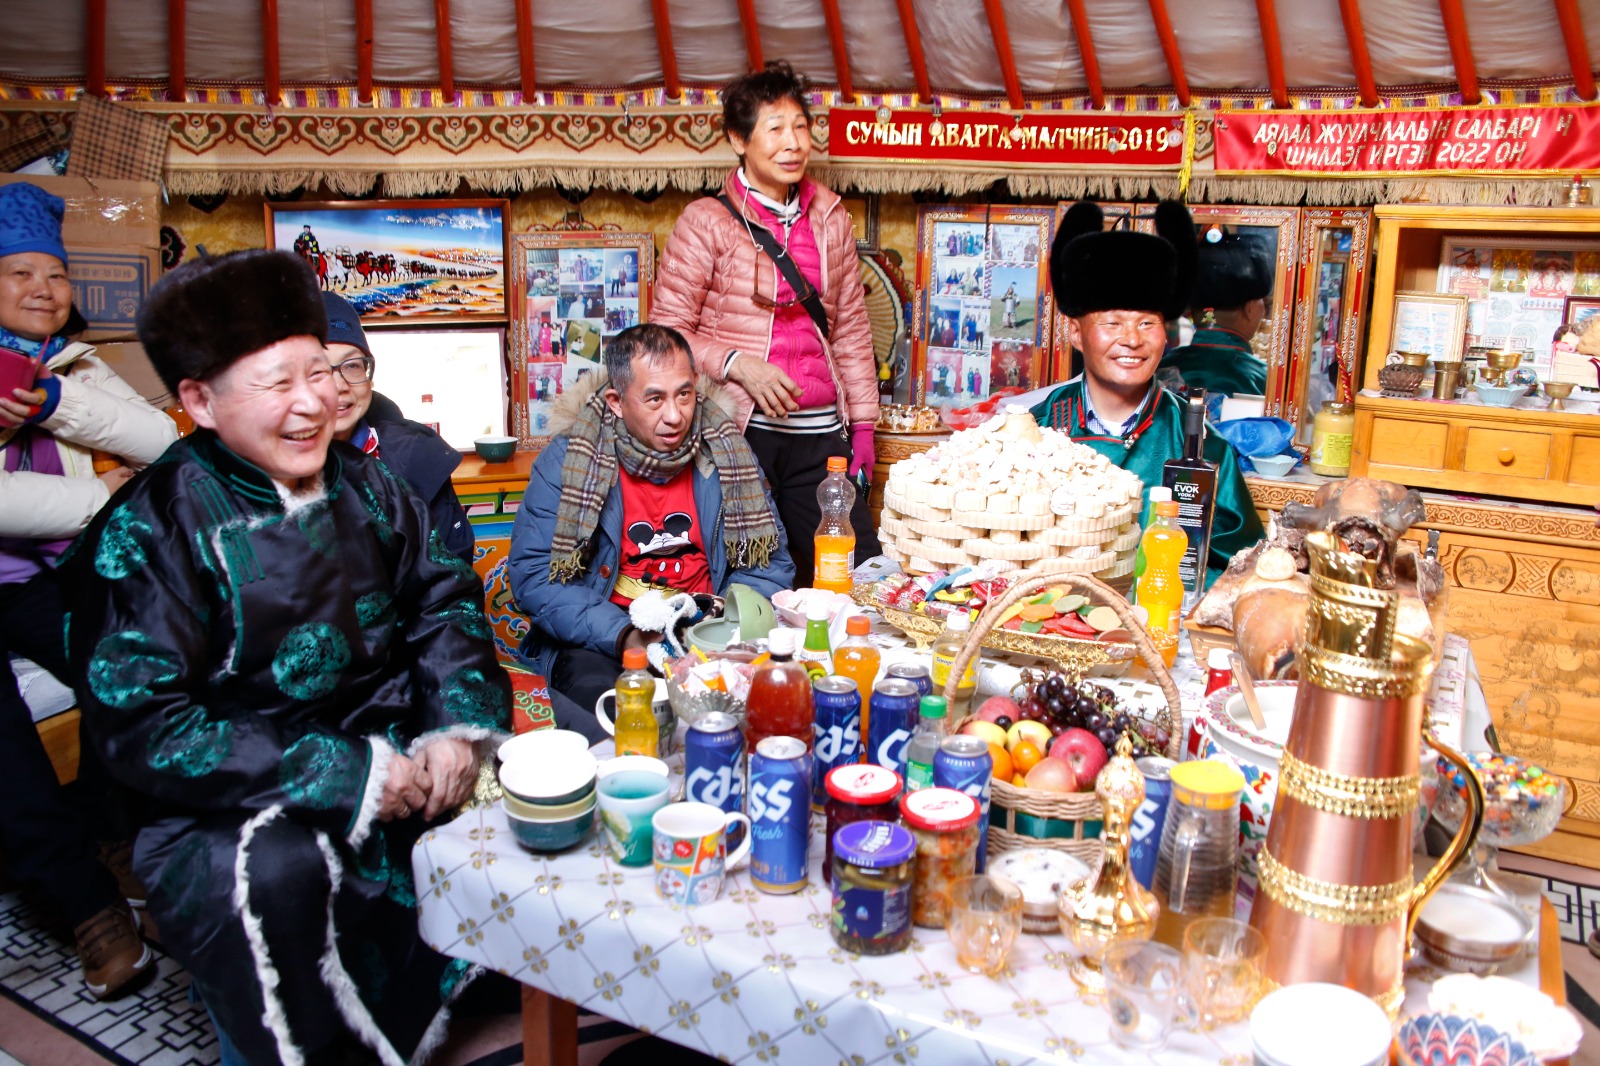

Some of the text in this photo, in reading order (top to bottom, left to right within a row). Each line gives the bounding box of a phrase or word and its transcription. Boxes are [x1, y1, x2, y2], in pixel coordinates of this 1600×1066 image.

[846, 120, 923, 146] СУМЫН
[1117, 126, 1169, 152] 2019
[1252, 122, 1311, 144] АЯЛАЛ
[1315, 118, 1451, 144] ЖУУЛЧЛАЛЫН
[1286, 141, 1528, 167] ШИЛДЭГ ИРГЭН 2022 ОН
[1174, 484, 1200, 494] EVOK
[752, 824, 784, 840] Fresh
